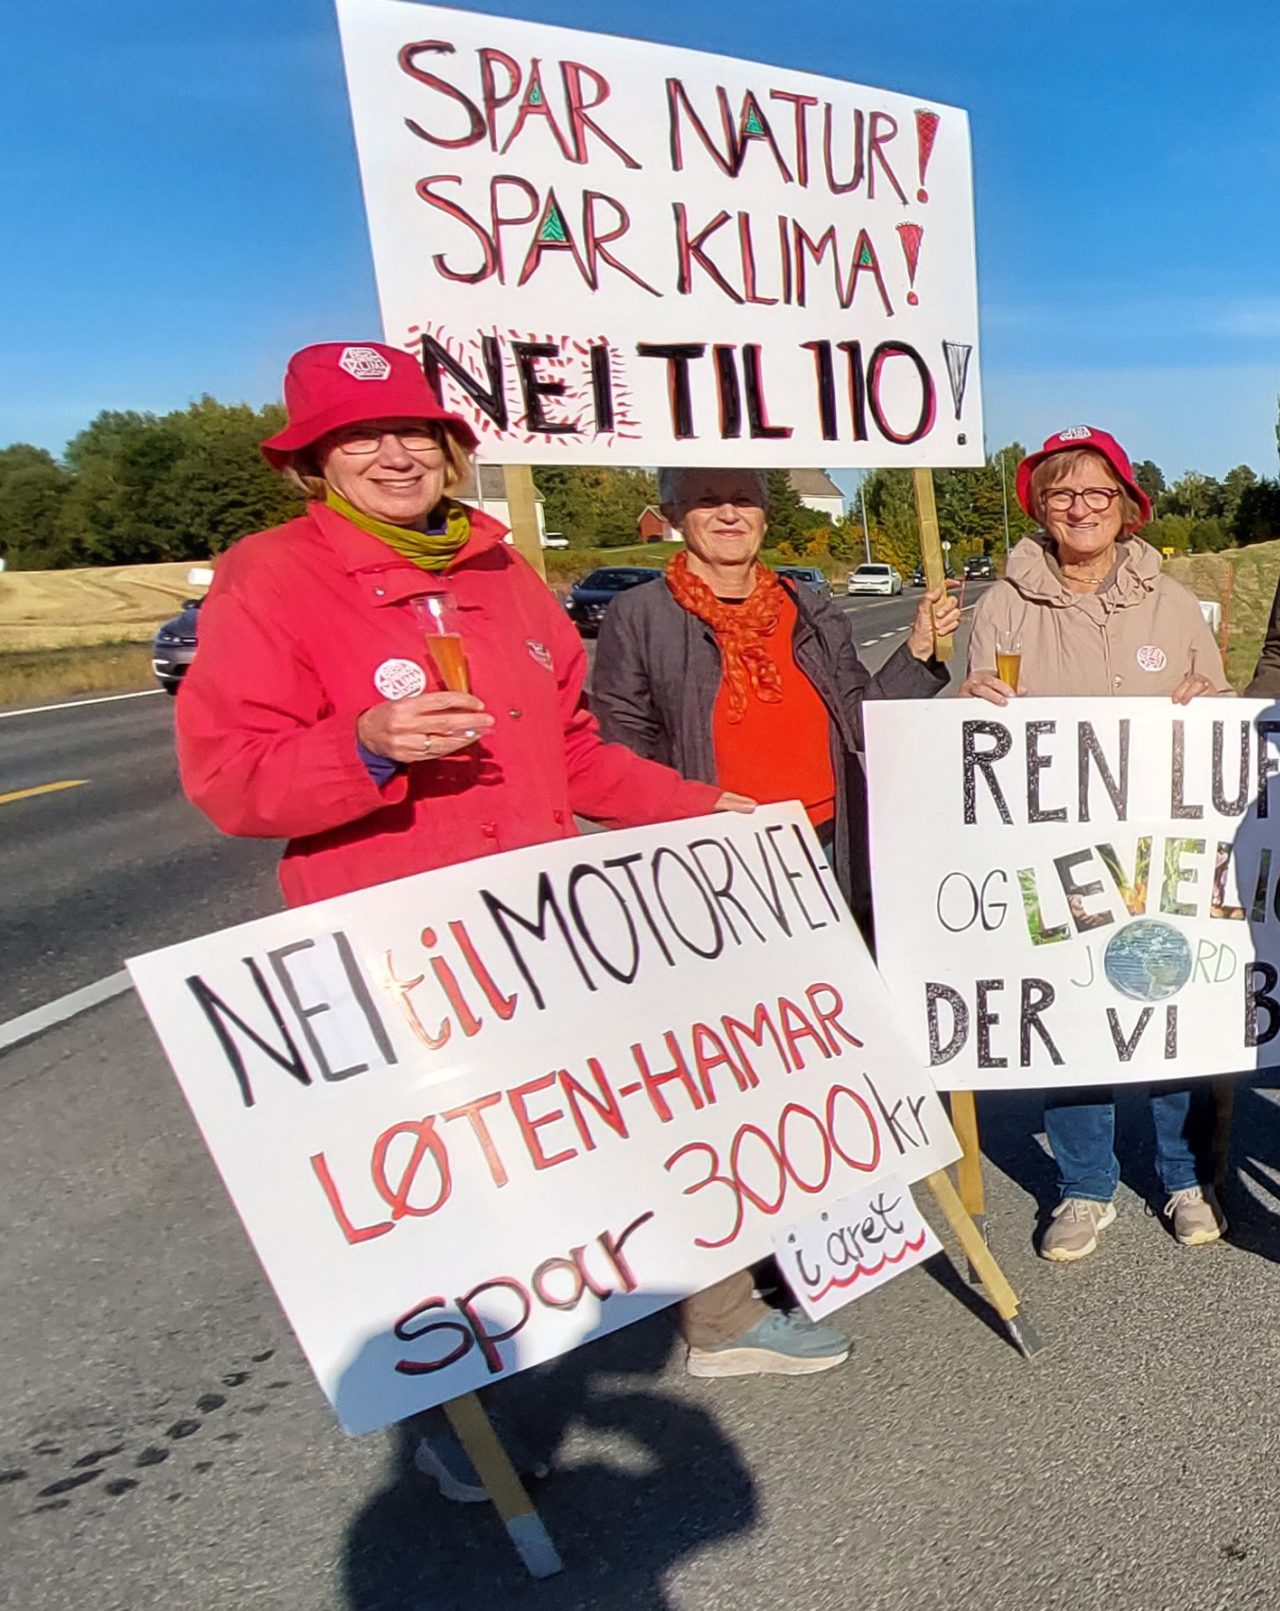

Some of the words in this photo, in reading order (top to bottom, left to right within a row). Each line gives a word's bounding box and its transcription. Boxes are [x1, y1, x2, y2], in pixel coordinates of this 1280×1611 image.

[398, 39, 642, 169] SPAR
[665, 78, 941, 206] NATUR!
[415, 174, 663, 298] SPAR
[672, 202, 925, 317] KLIMA!
[422, 332, 616, 434] NEI
[636, 341, 794, 441] TIL
[800, 339, 973, 447] 110!
[961, 718, 1131, 826] REN
[936, 868, 1009, 933] OG
[184, 930, 400, 1109] NEI
[381, 918, 519, 1052] til
[479, 823, 841, 1012] MOTORVEI-
[923, 977, 1067, 1070] DER
[1105, 1004, 1179, 1063] VI
[310, 981, 865, 1247] LØTEN-HAMAR
[393, 1210, 657, 1375] spar
[787, 1232, 822, 1287] i
